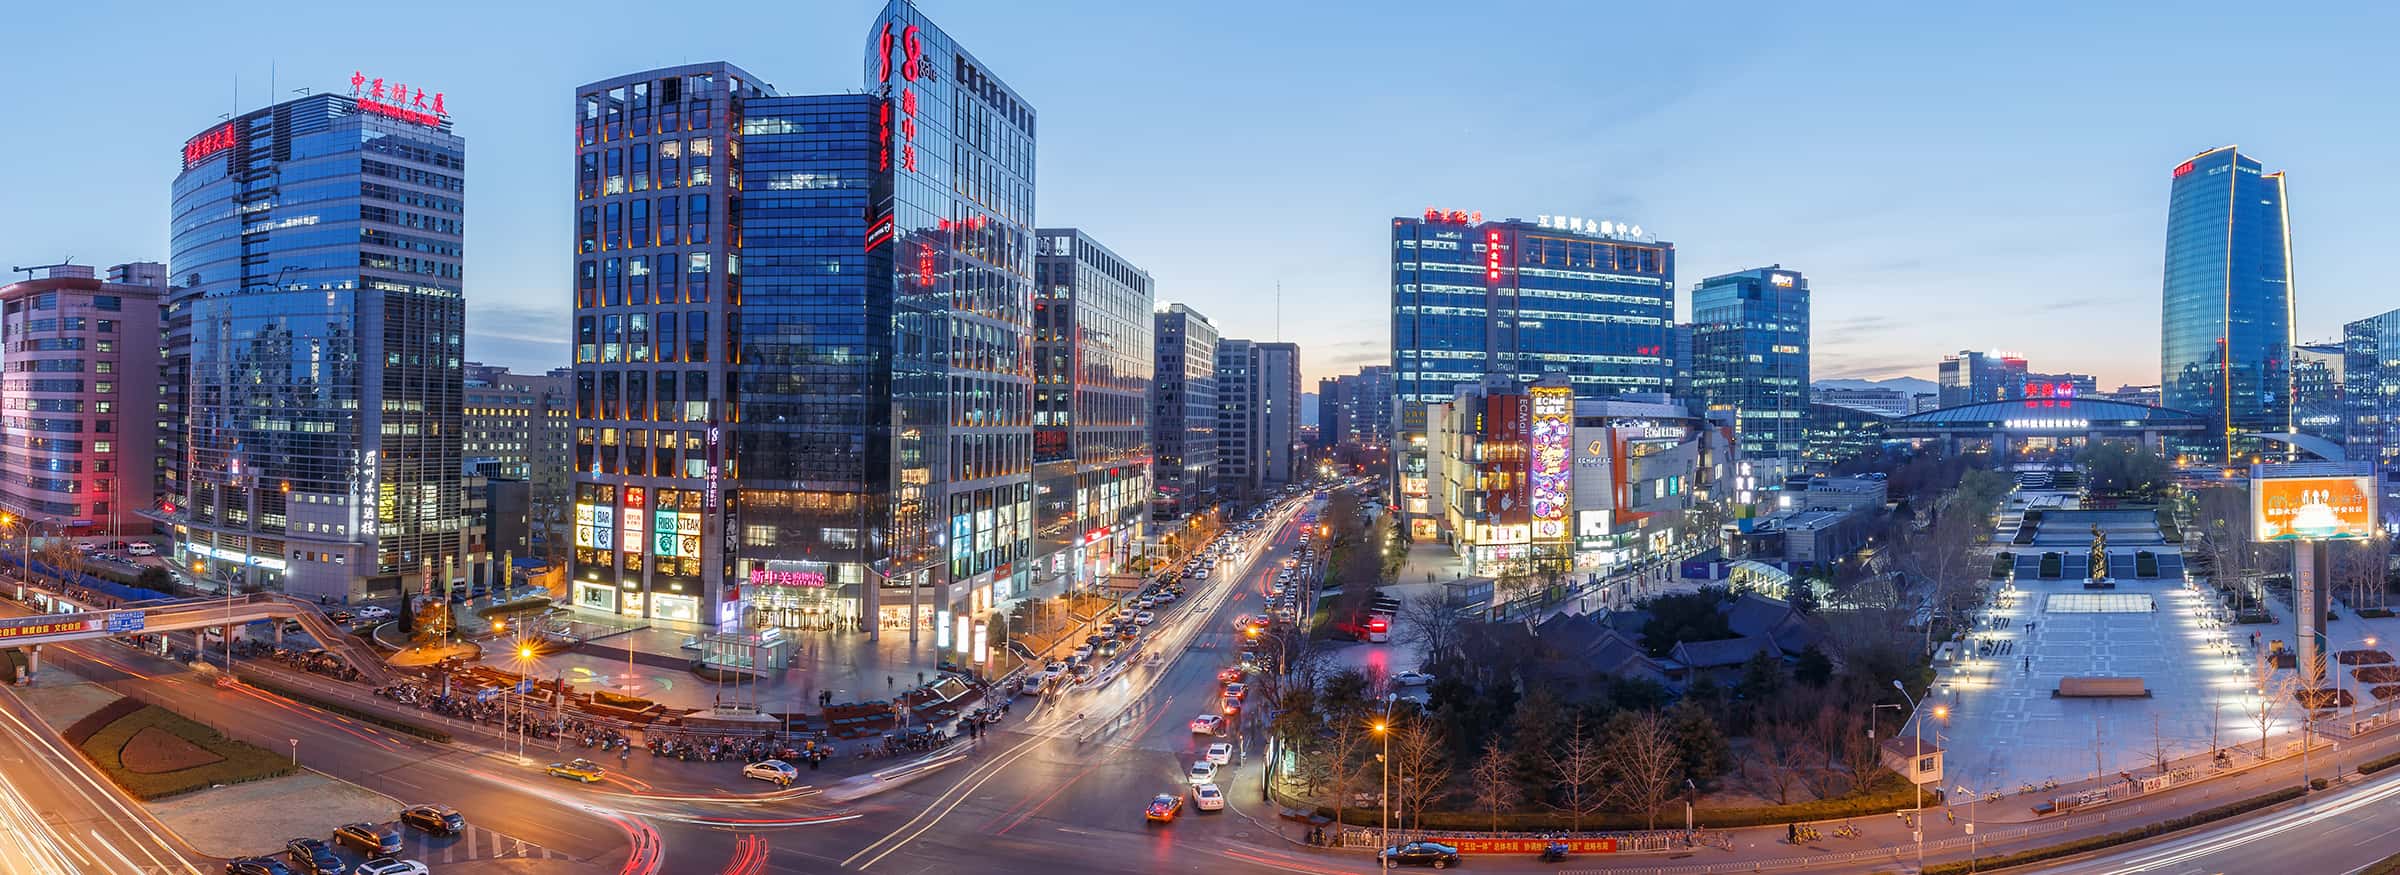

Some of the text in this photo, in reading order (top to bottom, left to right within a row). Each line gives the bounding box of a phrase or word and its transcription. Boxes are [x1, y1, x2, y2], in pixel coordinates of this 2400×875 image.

[902, 87, 917, 173] 新中关
[361, 450, 376, 535] 眉州东坡酒楼
[597, 511, 610, 524] BAR
[658, 516, 674, 530] RIBS
[752, 568, 792, 585] 新中关
